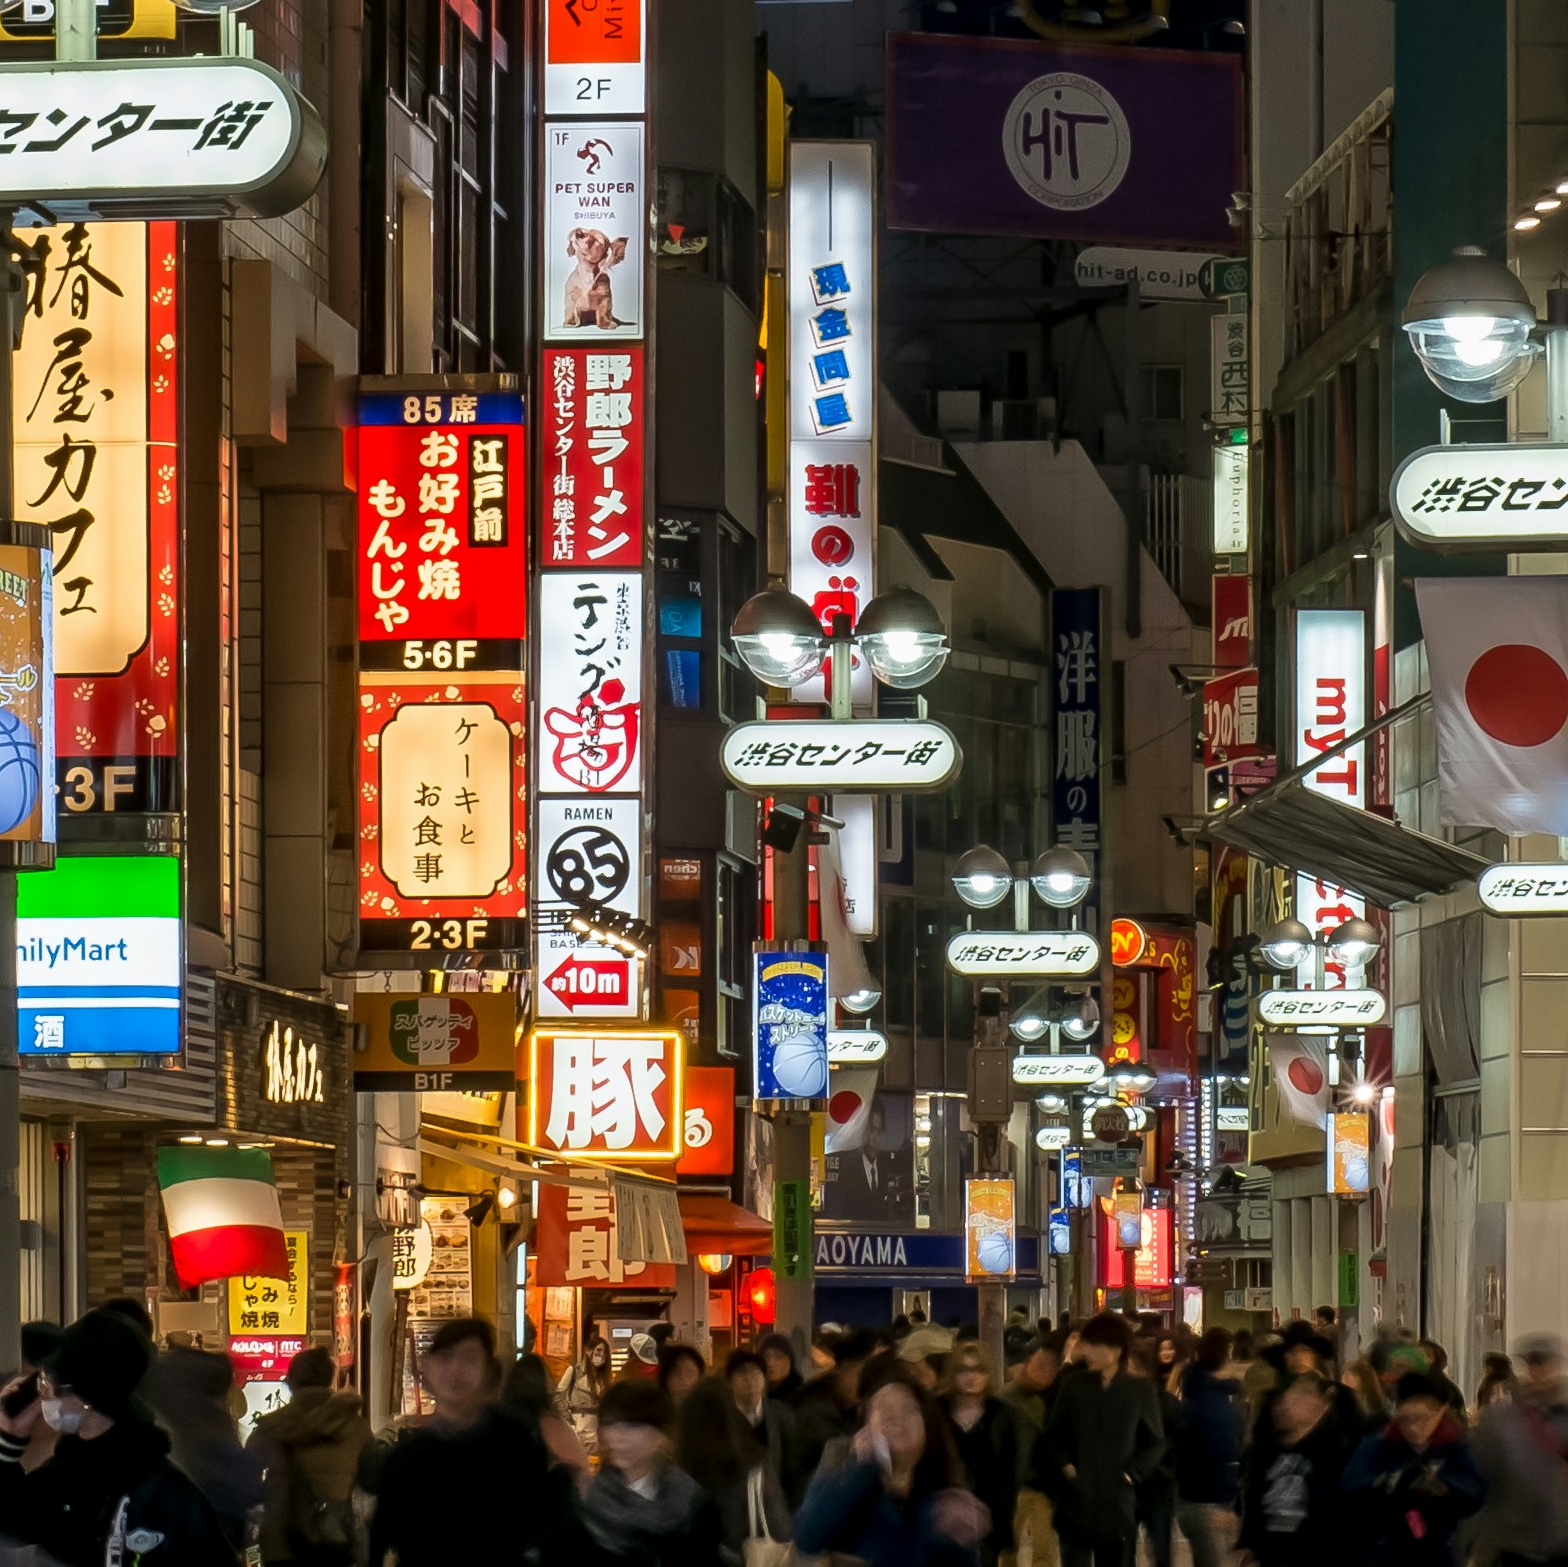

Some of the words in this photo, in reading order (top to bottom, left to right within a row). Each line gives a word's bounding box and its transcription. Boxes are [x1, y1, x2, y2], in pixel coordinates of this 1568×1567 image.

[576, 78, 612, 101] 2F
[555, 182, 582, 194] PET
[586, 182, 636, 194] SUPER
[578, 196, 611, 208] WAN
[403, 395, 478, 423] 85席
[552, 355, 575, 561] 渋谷センター街総本店
[586, 353, 633, 560] 野郎ラーメン
[472, 439, 504, 543] 江戸前
[418, 431, 461, 601] お好み焼
[367, 479, 410, 633] もんじゃ
[733, 740, 944, 770] 渋谷センター街
[454, 717, 480, 847] ケーキと
[564, 807, 614, 821] RAMEN
[412, 780, 445, 883] お食事
[17, 937, 128, 969] ilyMart
[954, 945, 1092, 964] 渋谷センター街
[394, 1013, 474, 1031] スパゲッティ
[1265, 998, 1378, 1016] 渋谷センター街
[34, 1014, 65, 1049] 酒
[406, 1036, 461, 1053] ピッツァ
[414, 1073, 453, 1090] B1F
[544, 1039, 667, 1149] 豚
[816, 1235, 908, 1267] AOYAMA
